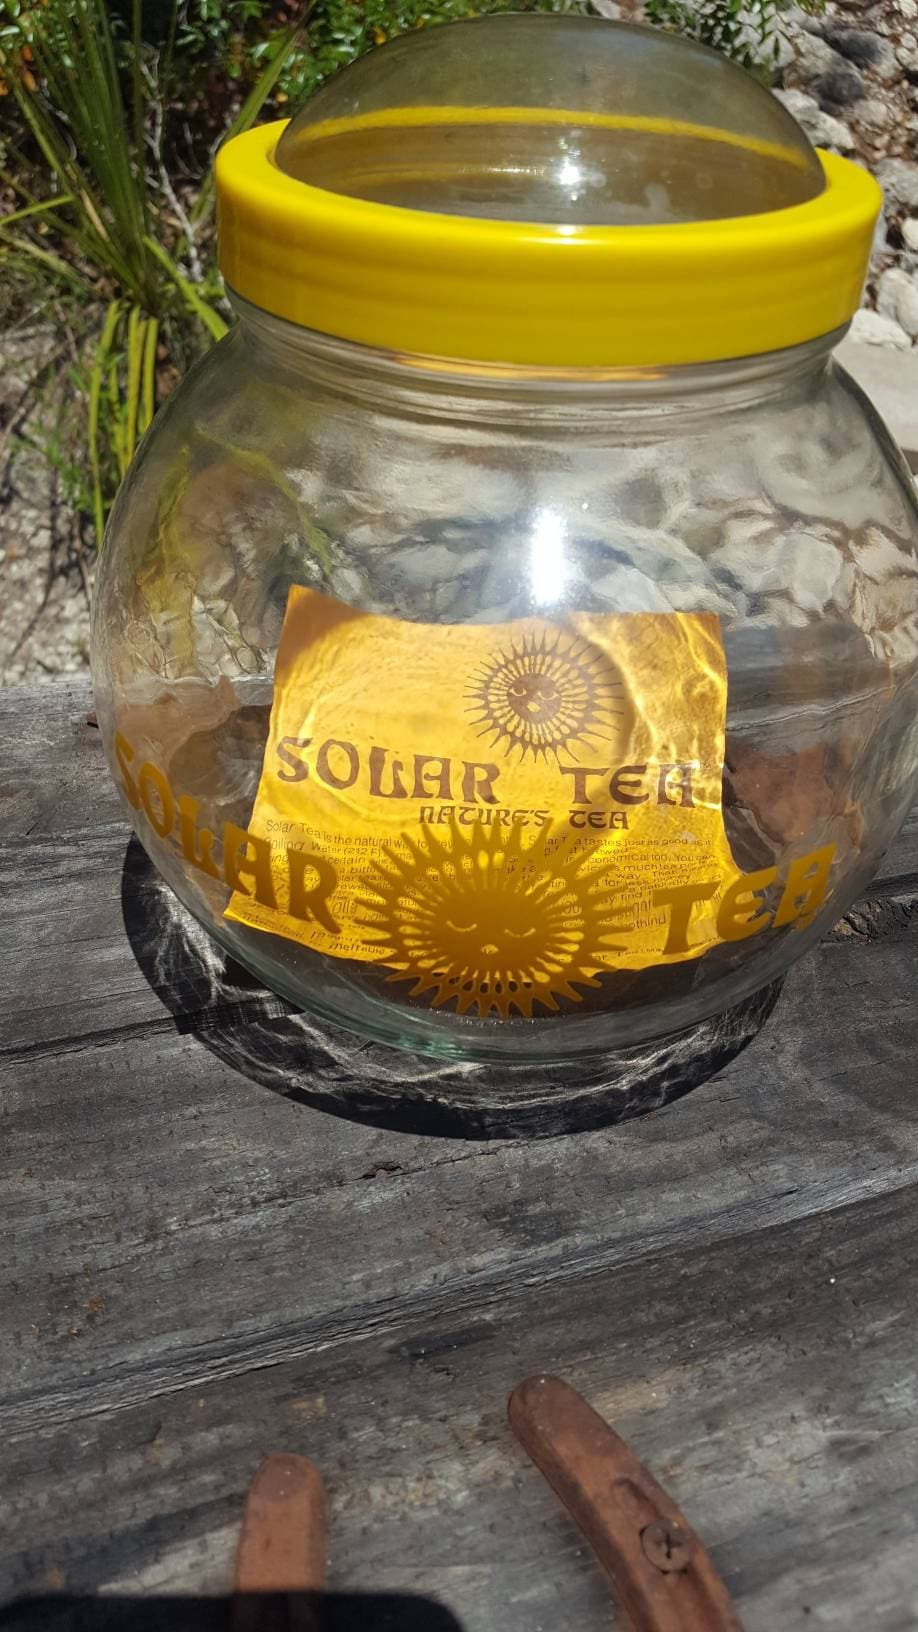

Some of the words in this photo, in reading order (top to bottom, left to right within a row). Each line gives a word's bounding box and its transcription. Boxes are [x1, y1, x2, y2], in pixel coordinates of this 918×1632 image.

[277, 736, 501, 805] SOLAR
[559, 761, 696, 809] TEA
[569, 810, 630, 831] TEA
[113, 732, 341, 935] SOLAR
[653, 842, 838, 956] TEA
[266, 819, 295, 833] Solar
[299, 822, 320, 839] Tea
[332, 833, 352, 847] the
[354, 836, 391, 850] natural
[393, 838, 411, 850] wa
[312, 841, 342, 854] Water
[588, 853, 648, 865] conomical
